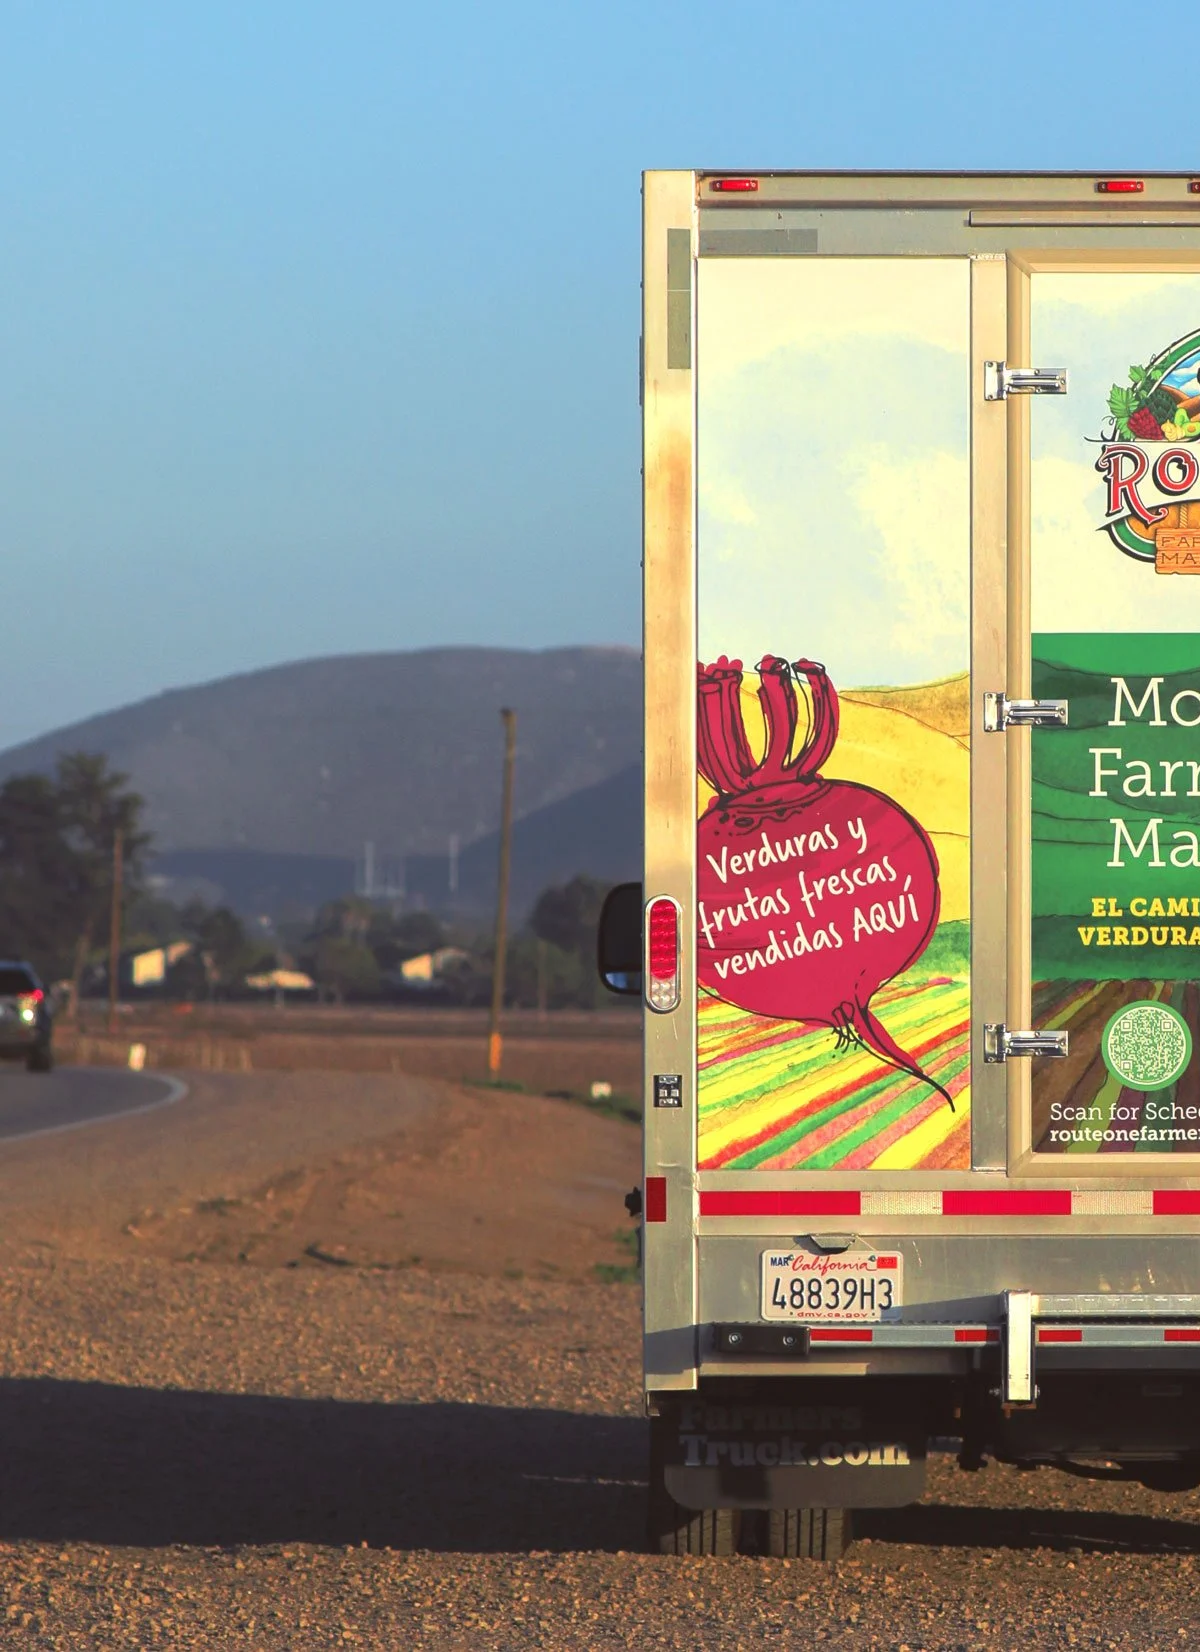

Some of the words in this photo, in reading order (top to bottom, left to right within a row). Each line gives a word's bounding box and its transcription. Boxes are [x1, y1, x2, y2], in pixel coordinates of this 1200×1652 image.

[706, 823, 839, 884] Verduras
[847, 817, 867, 854] y
[698, 887, 790, 949] frutas
[799, 855, 896, 918] frescas
[1091, 898, 1123, 917] EL
[714, 921, 843, 979] vendidas
[853, 874, 919, 942] AQUÍ
[1050, 1103, 1102, 1121] Scan
[1108, 1102, 1139, 1121] for
[770, 1256, 790, 1267] MAR
[792, 1255, 877, 1276] California
[772, 1278, 893, 1310] 48839H3
[797, 1311, 868, 1319] dmv.ca.gov
[679, 1433, 911, 1466] Truck.com
